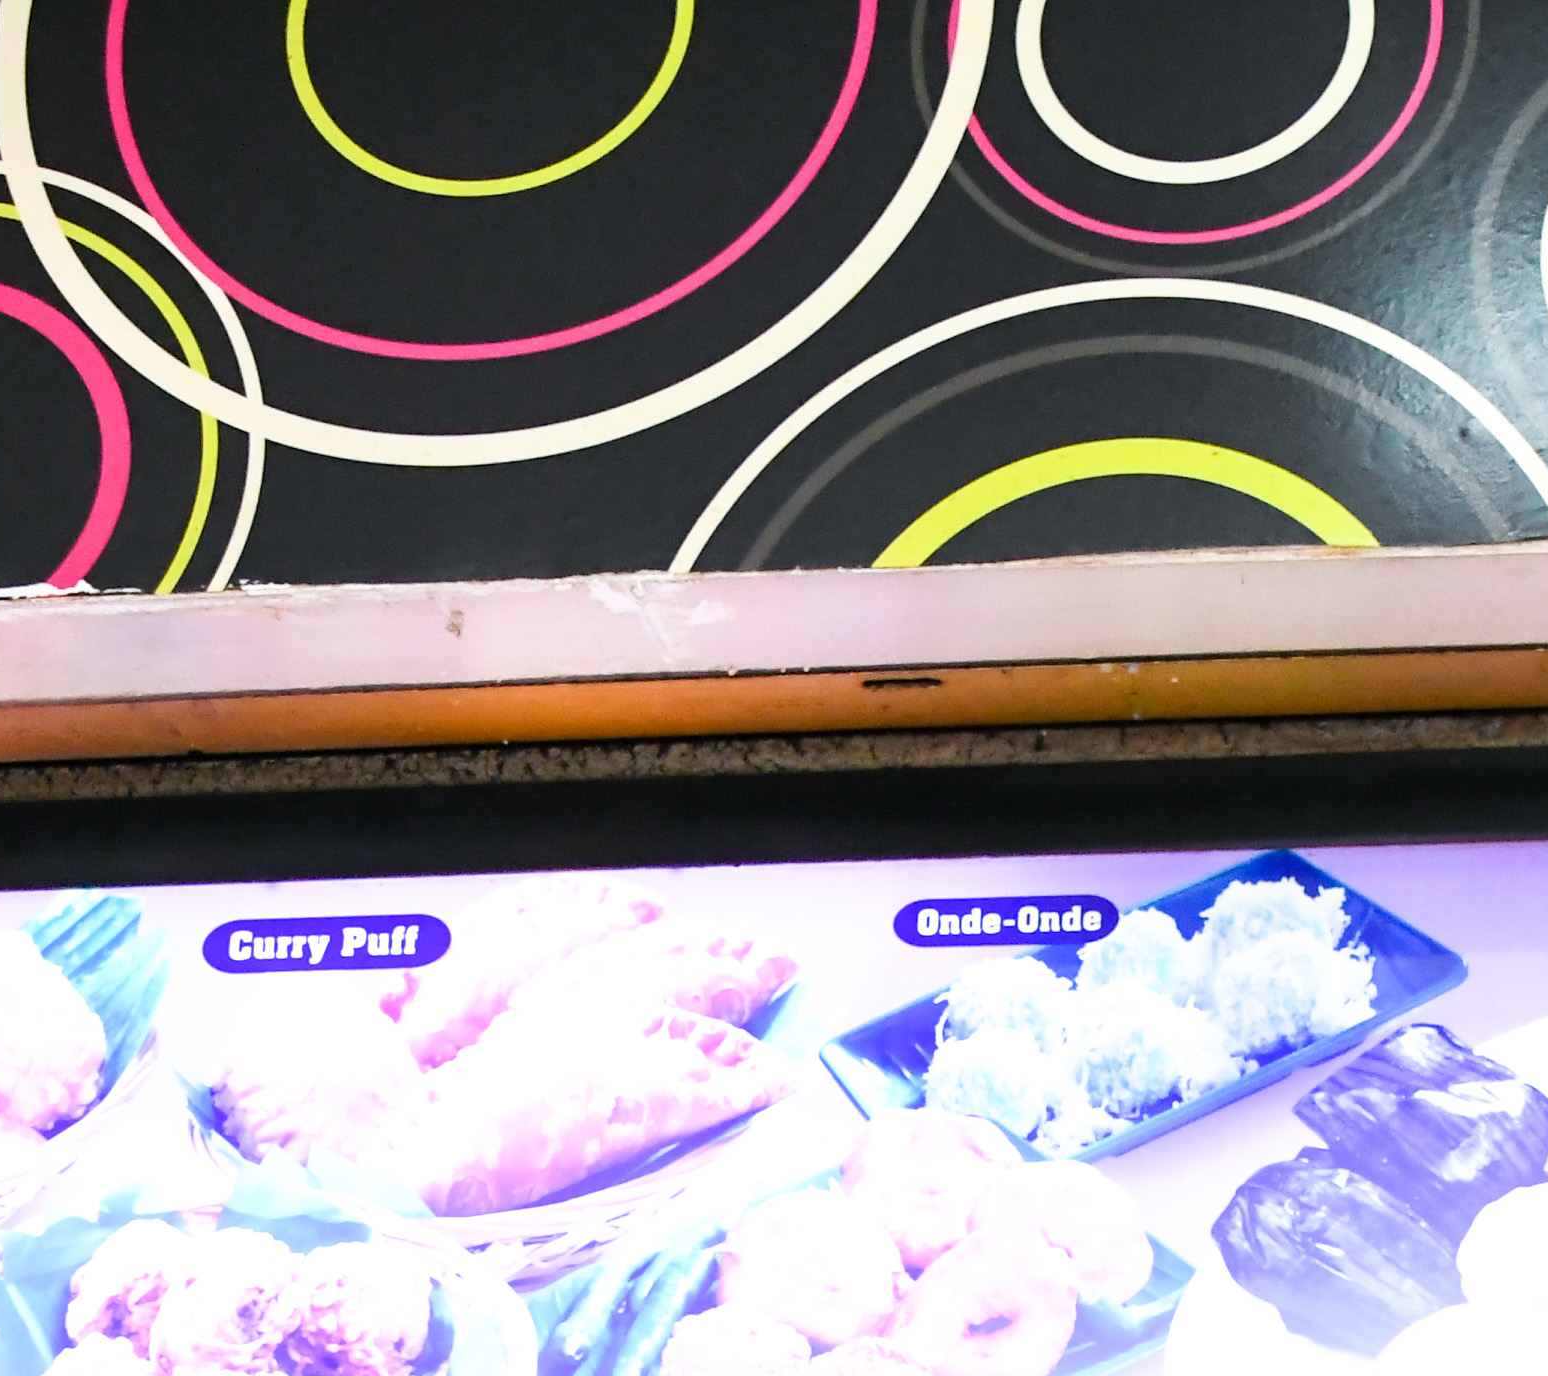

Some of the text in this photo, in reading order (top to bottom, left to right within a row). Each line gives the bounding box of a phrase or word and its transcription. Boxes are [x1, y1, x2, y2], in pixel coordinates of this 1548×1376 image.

[917, 905, 1102, 936] Onde-Onde
[229, 925, 419, 965] Curry Puff
